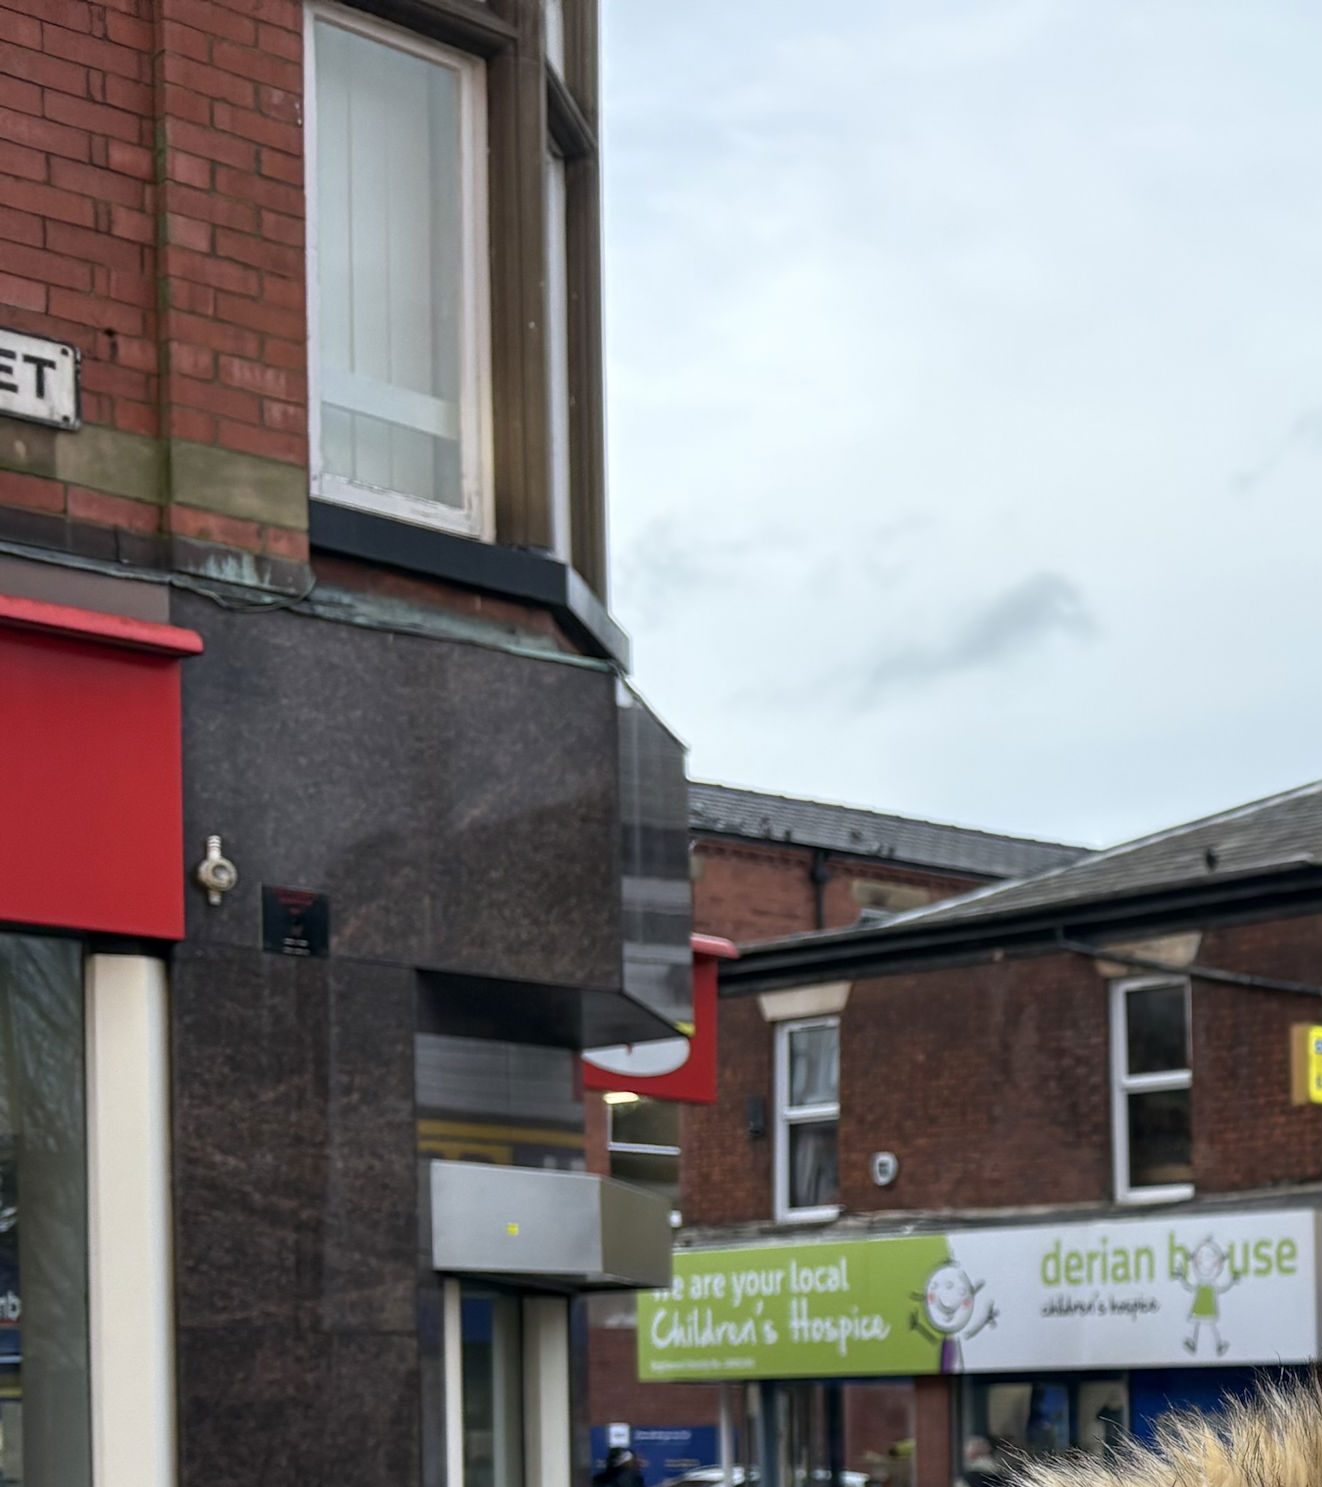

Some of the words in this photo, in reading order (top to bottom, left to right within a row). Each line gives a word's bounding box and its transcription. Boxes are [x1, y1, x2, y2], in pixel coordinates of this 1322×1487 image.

[0, 347, 56, 399] ET
[690, 1273, 726, 1300] are
[731, 1269, 785, 1308] your
[790, 1256, 849, 1295] local
[1041, 1239, 1154, 1287] derian
[651, 1300, 778, 1349] Children's
[789, 1297, 891, 1357] Hospice
